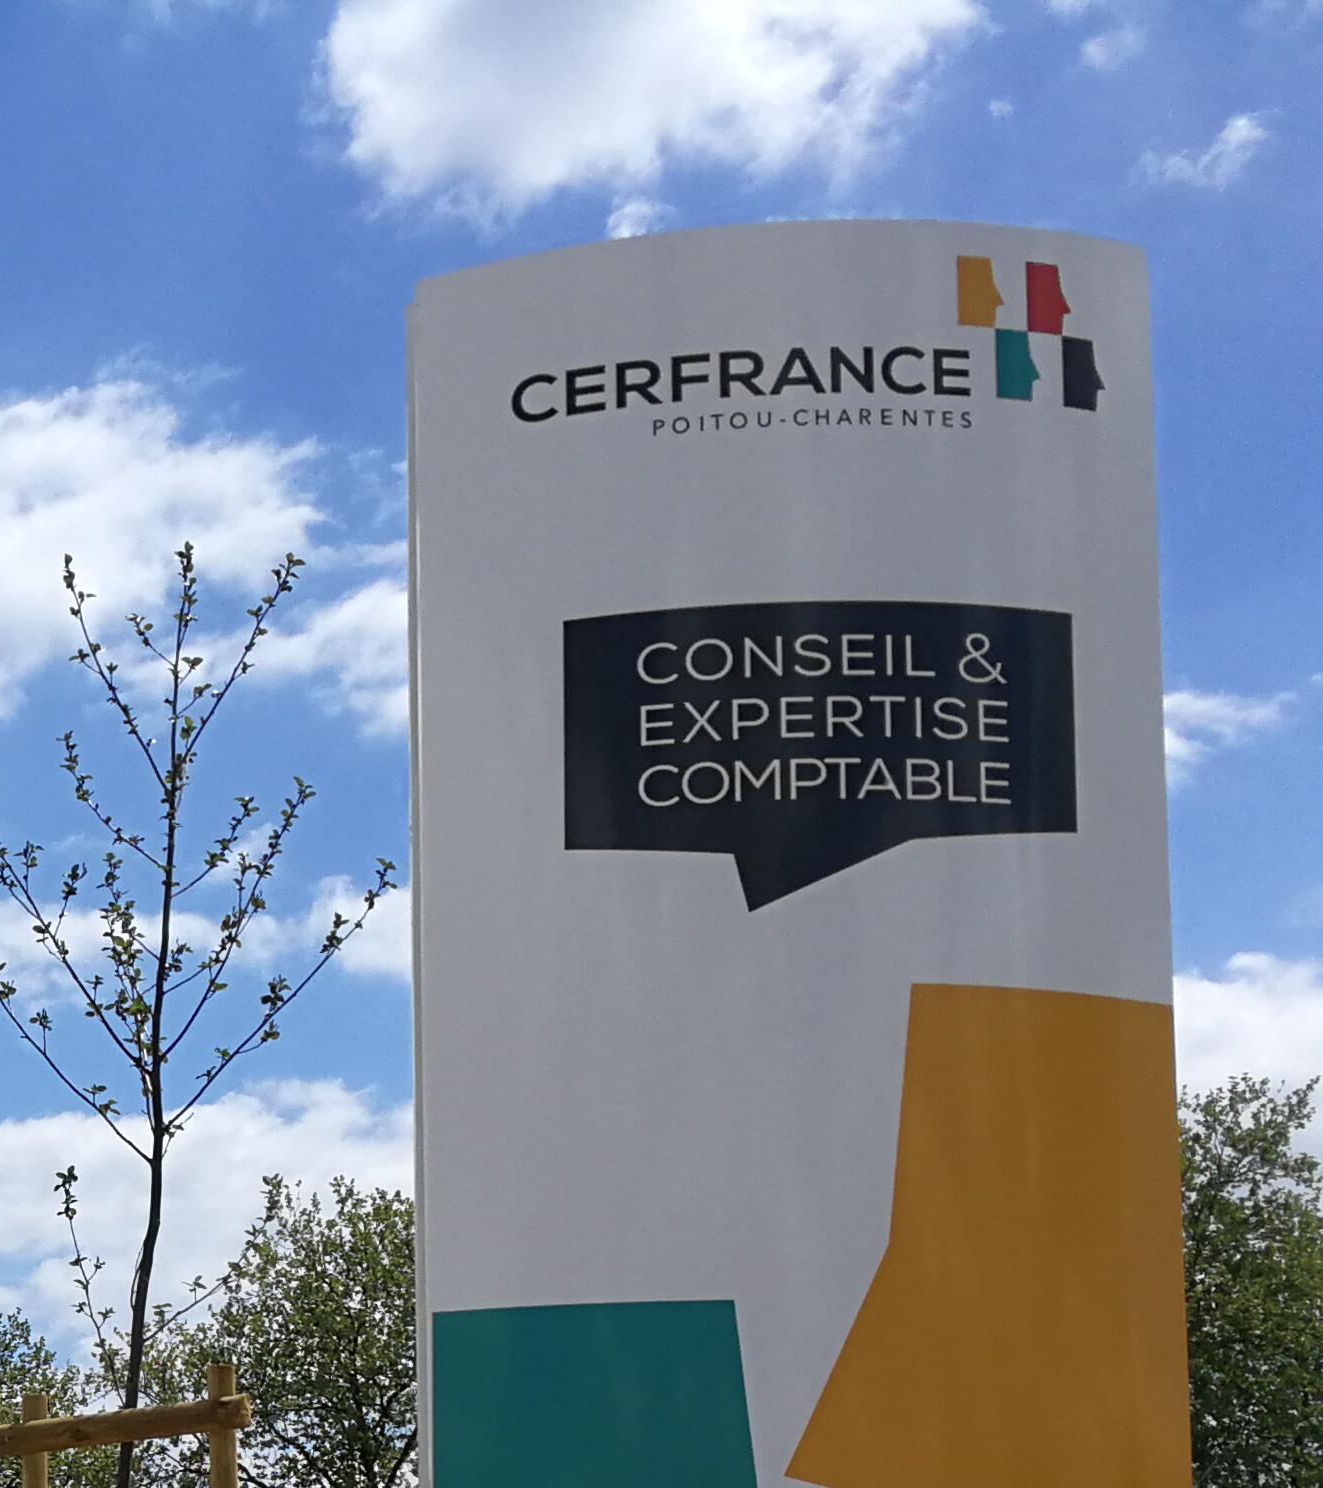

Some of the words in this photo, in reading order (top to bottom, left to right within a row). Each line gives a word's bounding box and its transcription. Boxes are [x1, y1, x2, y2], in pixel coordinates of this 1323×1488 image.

[510, 345, 972, 423] CERFRANCE
[653, 408, 973, 436] POITOU-CHARENTES
[636, 633, 936, 686] CONSEIL
[957, 632, 1008, 685] &
[639, 695, 1011, 747] EXPERTISE
[637, 756, 1013, 808] COMPTABLE
